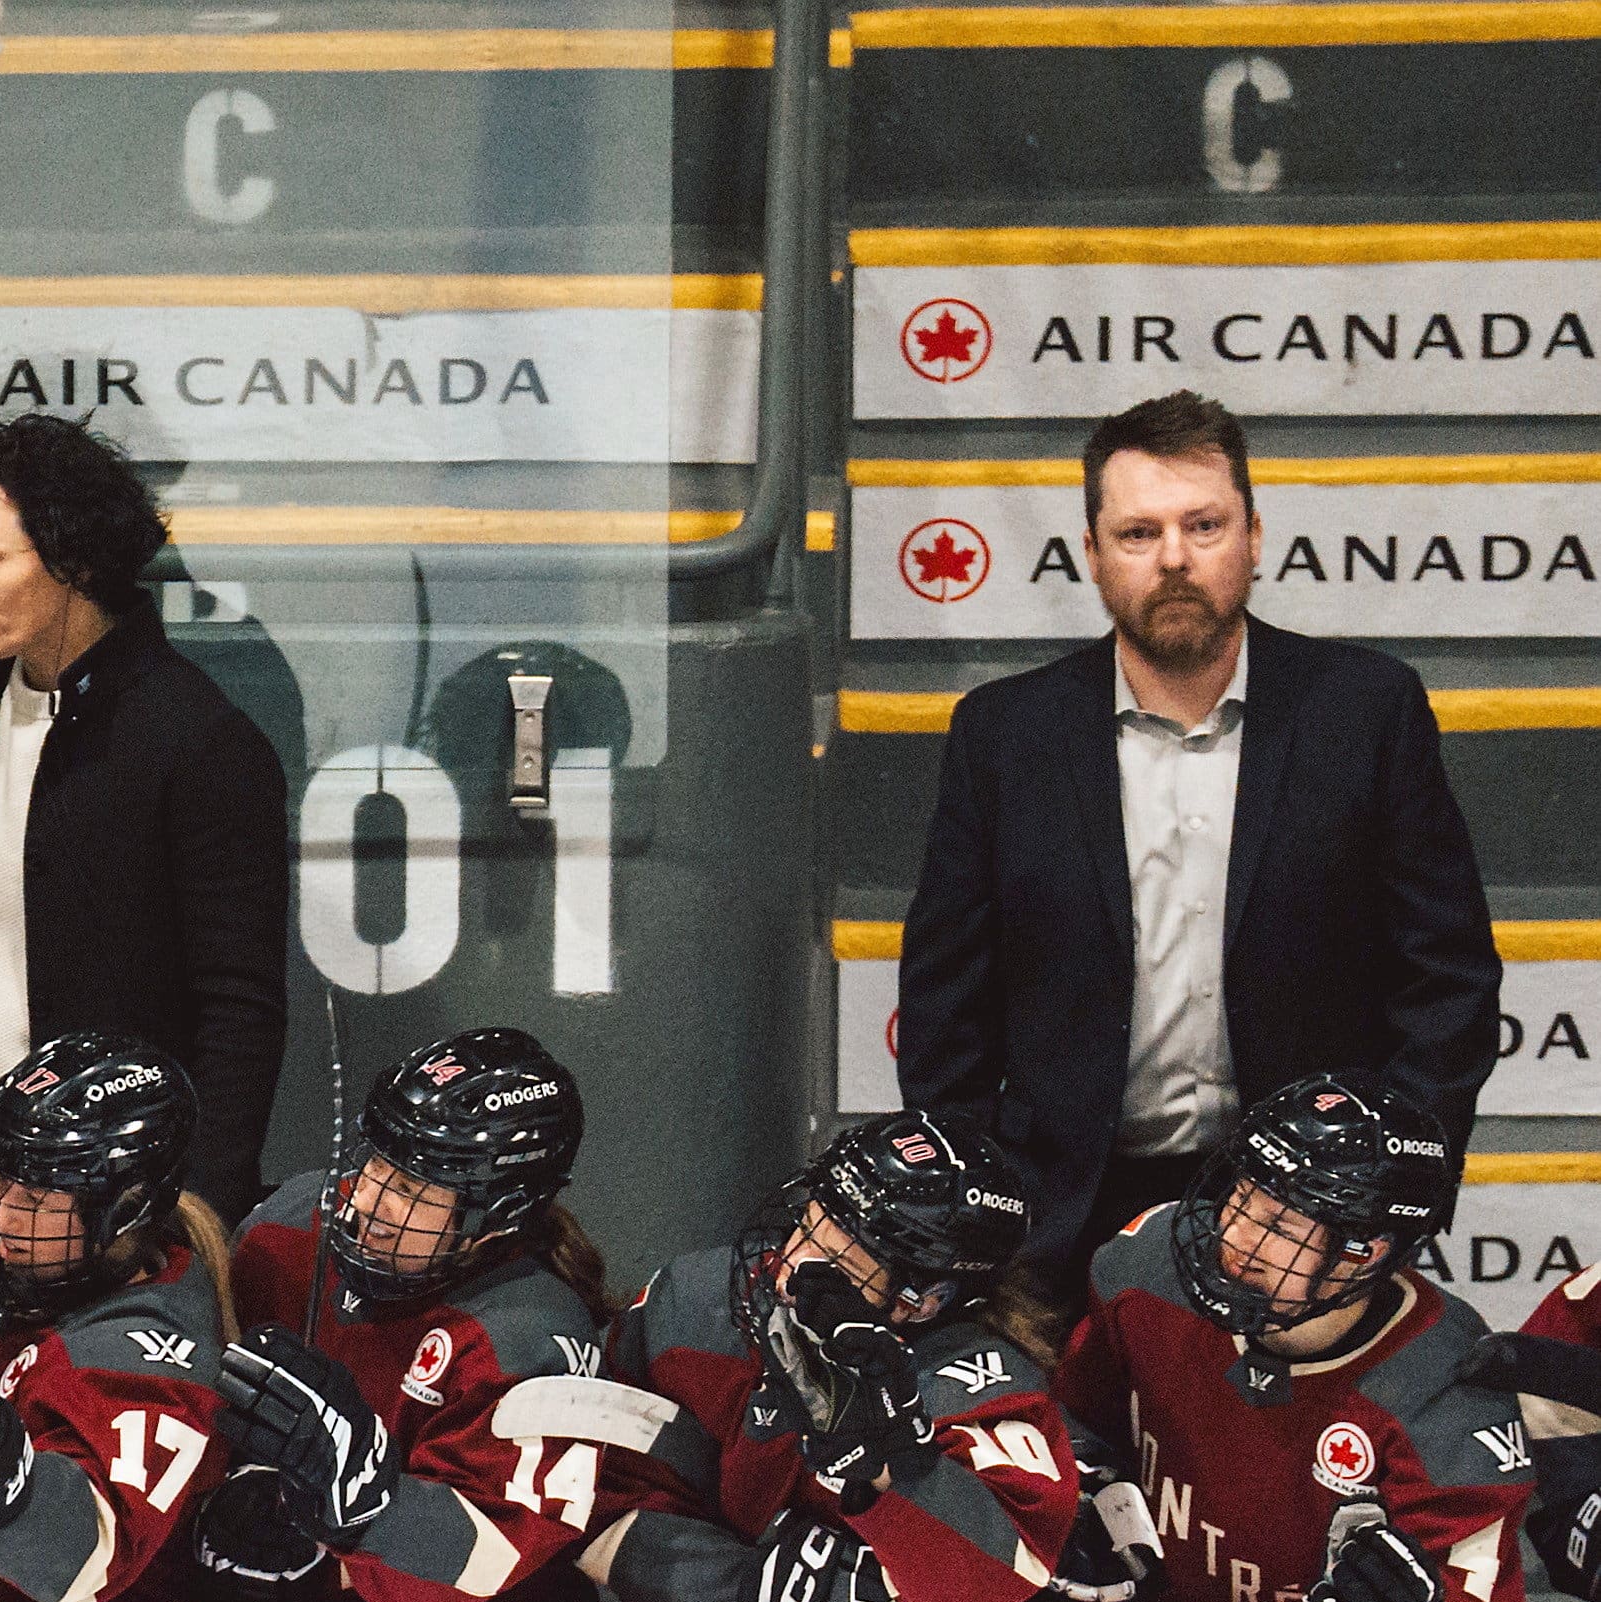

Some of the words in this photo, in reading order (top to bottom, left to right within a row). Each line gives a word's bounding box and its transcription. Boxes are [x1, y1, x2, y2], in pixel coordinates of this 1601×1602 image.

[1203, 57, 1294, 193] C
[185, 88, 277, 223] C
[1032, 315, 1181, 363] AIR
[1212, 312, 1597, 364] CANADA
[177, 357, 551, 406] CANADA
[1252, 535, 1596, 583] ANADA
[105, 1064, 163, 1096] ROGERS
[501, 1080, 559, 1108] ROGERS
[892, 1132, 937, 1163] 10
[981, 1191, 1025, 1215] ROGERS
[1248, 1132, 1298, 1173] CCM
[1402, 1141, 1445, 1158] ROGERS
[1388, 1203, 1431, 1218] CCM
[1413, 1234, 1582, 1284] ADA
[110, 1410, 210, 1514] 17
[951, 1420, 1062, 1482] 10
[502, 1437, 599, 1532] 14
